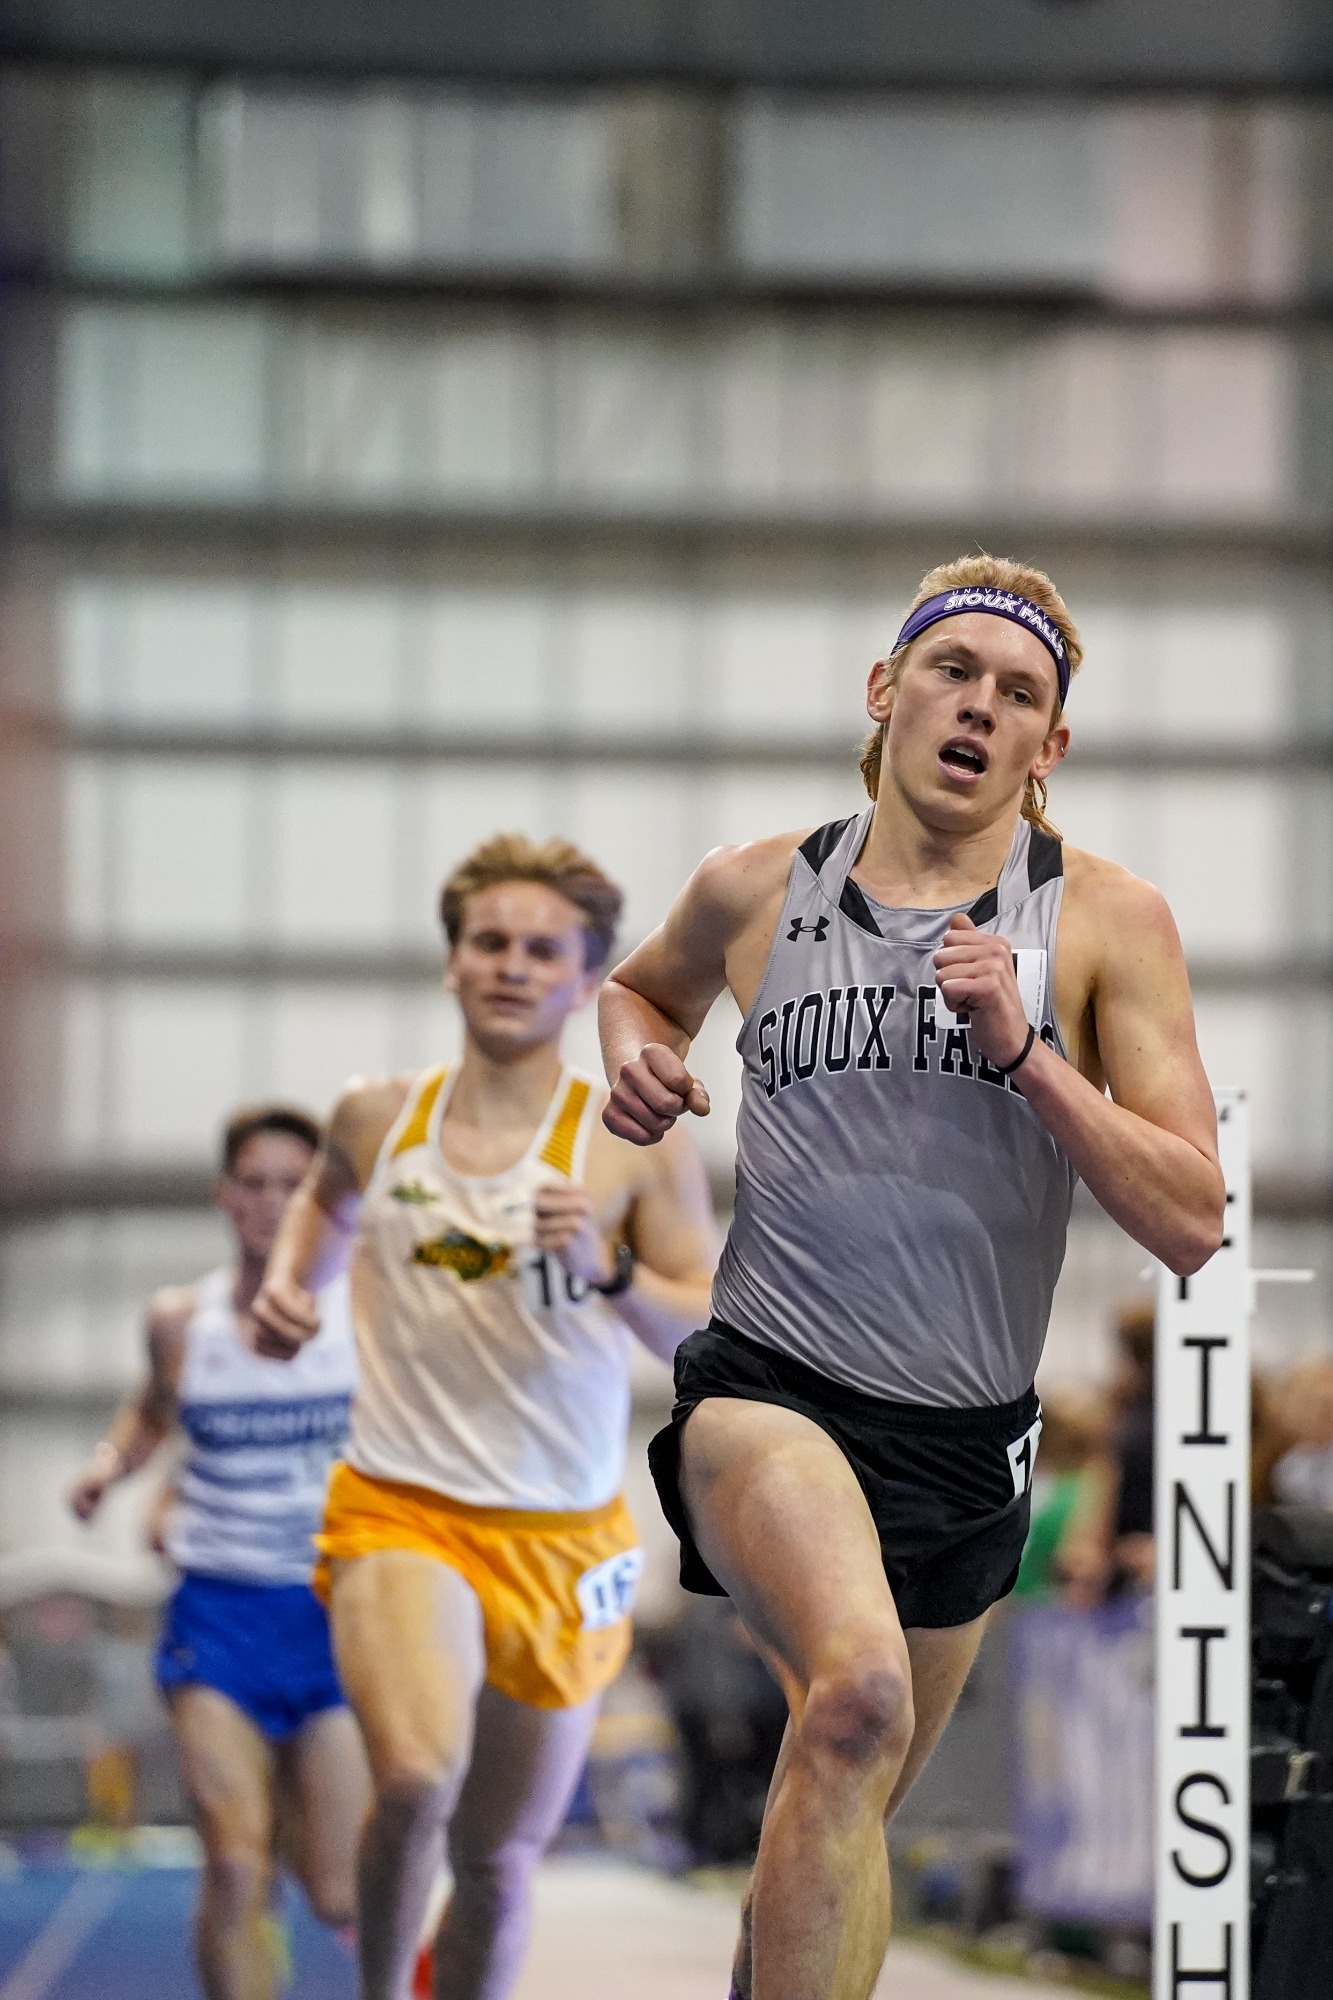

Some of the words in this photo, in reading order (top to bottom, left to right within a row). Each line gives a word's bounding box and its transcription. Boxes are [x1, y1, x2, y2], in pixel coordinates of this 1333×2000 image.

[943, 592, 1018, 614] SIOUX
[1018, 605, 1064, 660] FALLS
[952, 588, 1049, 620] UNIVERSITY
[757, 984, 897, 1102] SIOUX
[1171, 1191, 1234, 2000] INISH
